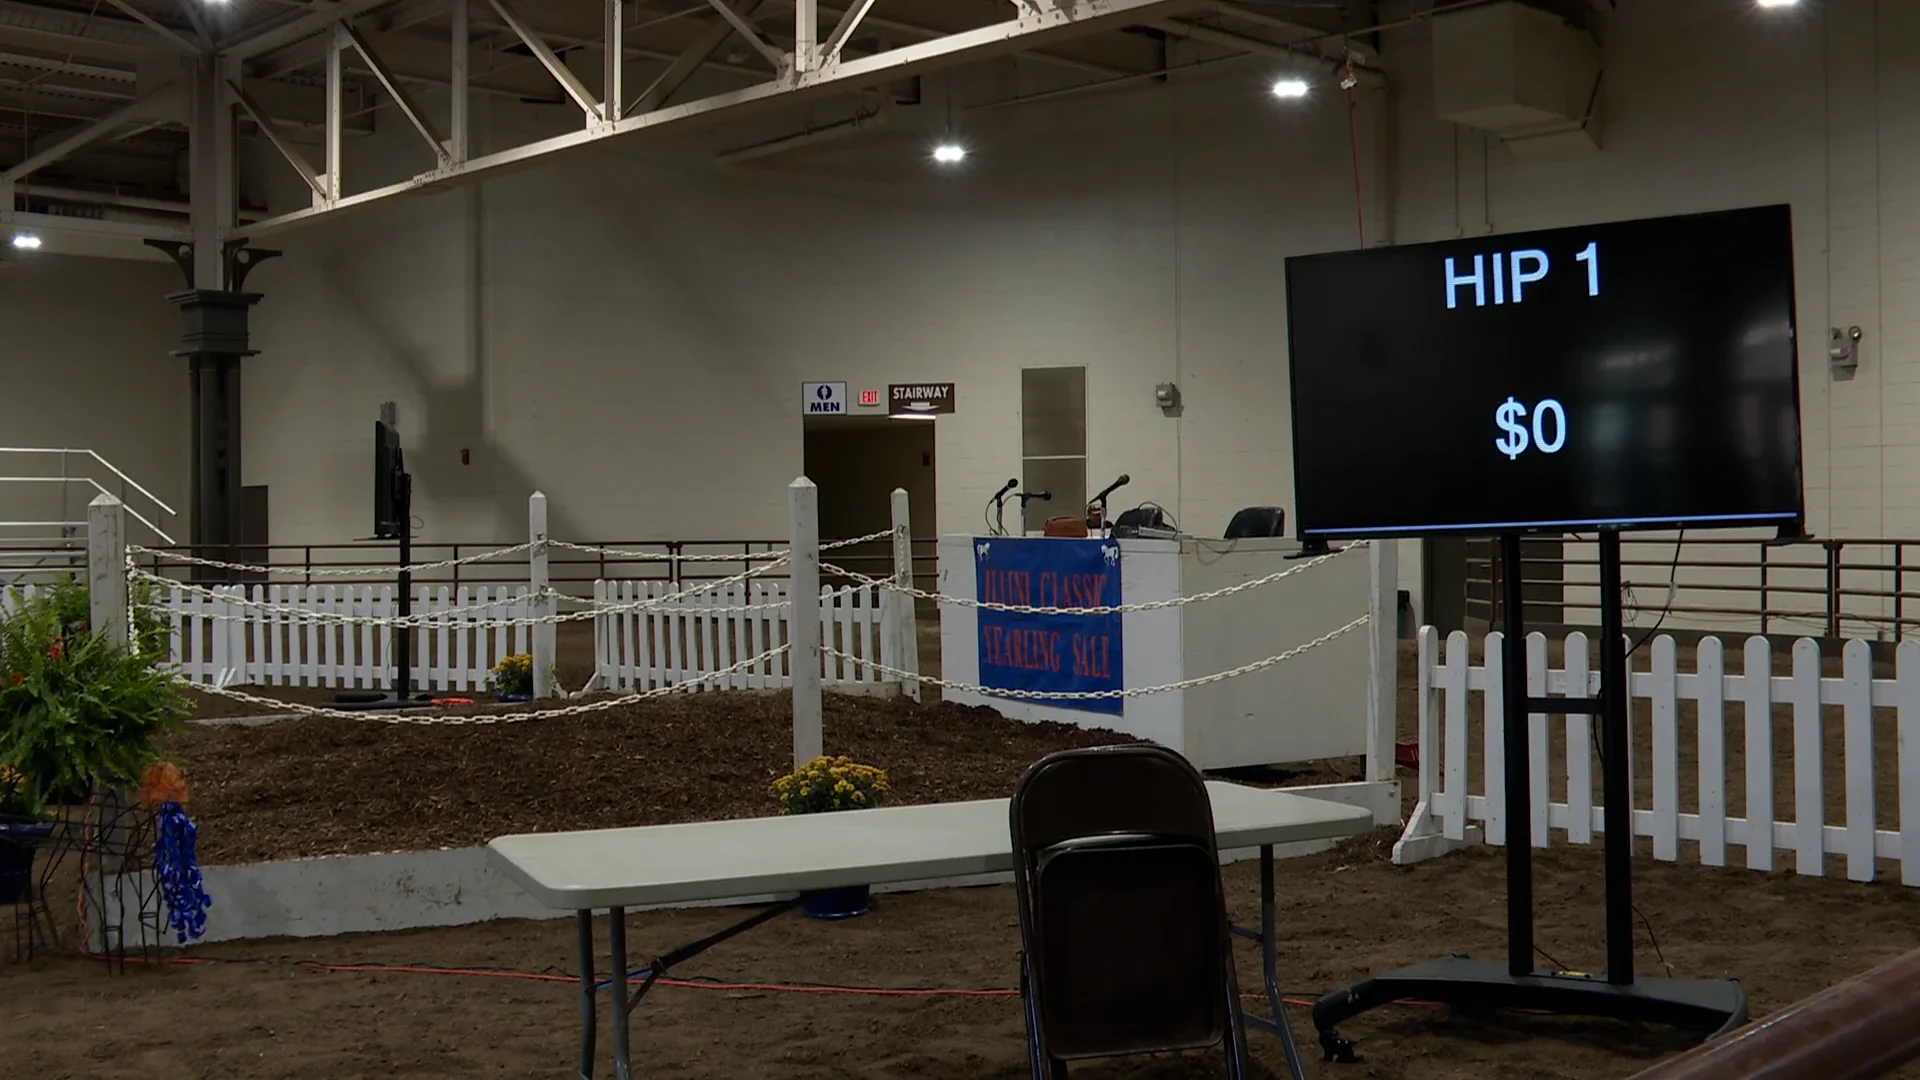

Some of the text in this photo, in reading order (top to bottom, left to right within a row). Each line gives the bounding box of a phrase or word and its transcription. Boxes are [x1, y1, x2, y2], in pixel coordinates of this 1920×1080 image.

[1444, 241, 1599, 309] HIP 1
[810, 402, 840, 412] MEN
[862, 390, 878, 403] EXIT
[892, 385, 949, 400] STAIRWAY
[1495, 396, 1566, 460] $0
[1039, 571, 1108, 616] CLASSIC
[983, 625, 1111, 679] YEARLING SALE
